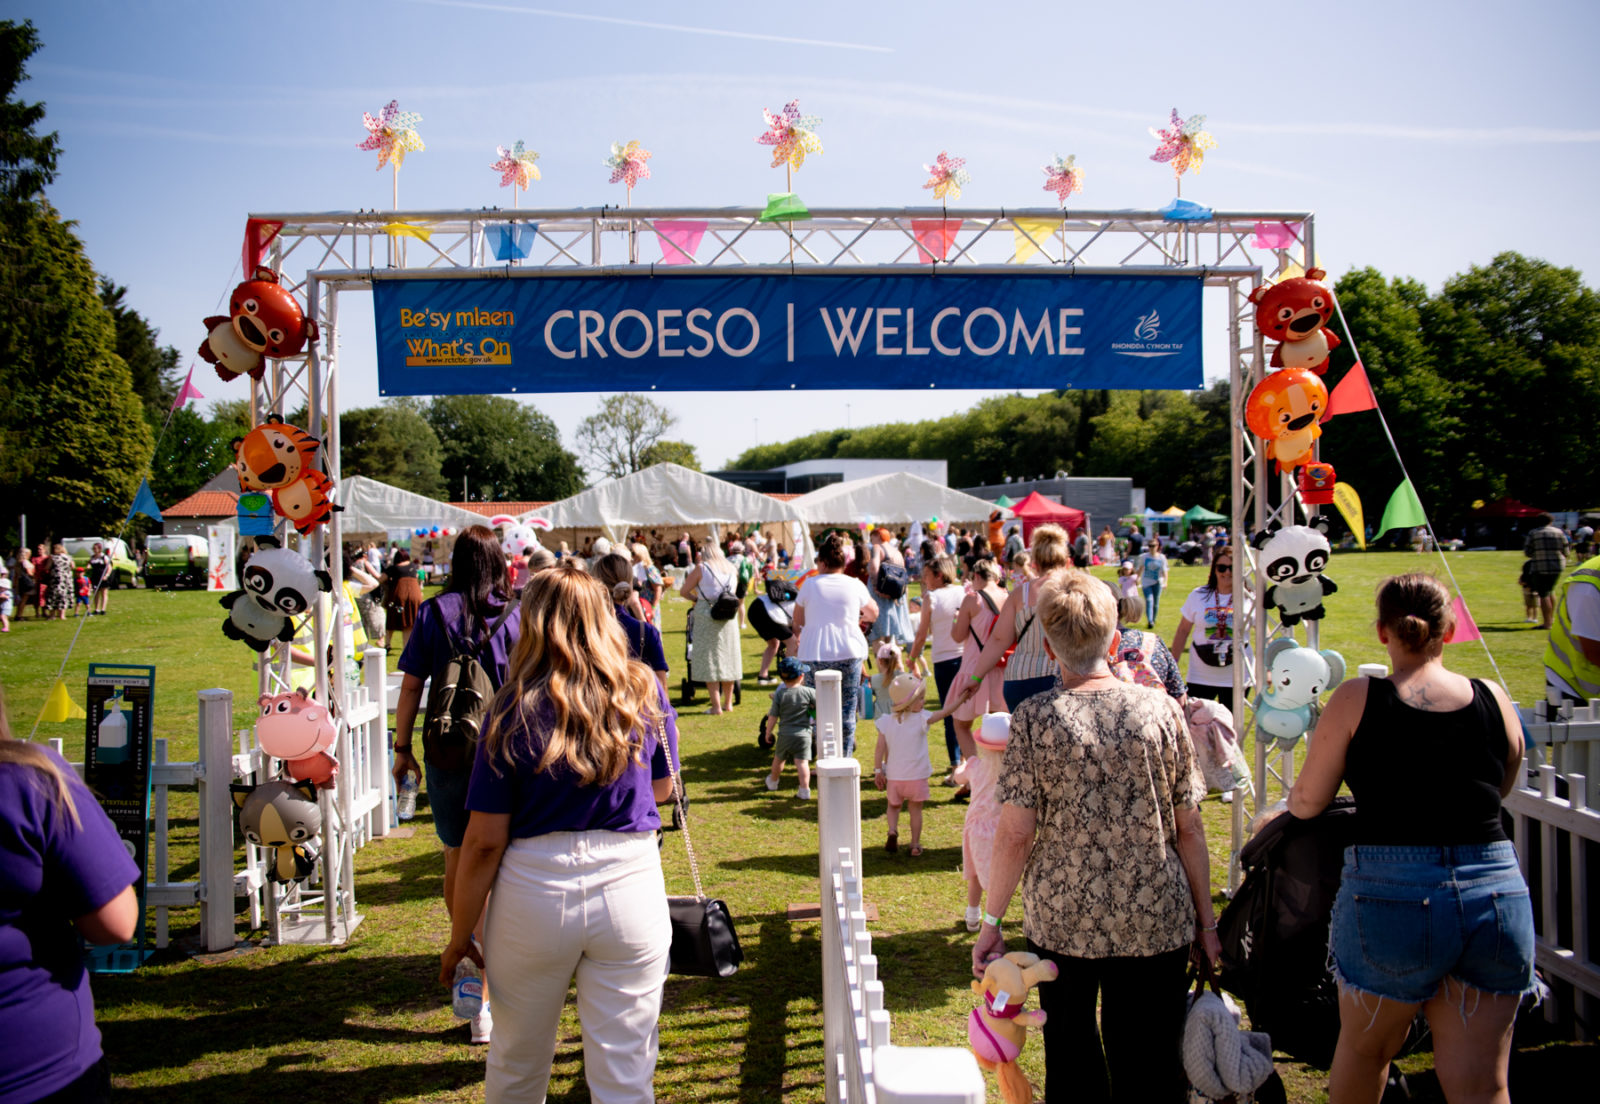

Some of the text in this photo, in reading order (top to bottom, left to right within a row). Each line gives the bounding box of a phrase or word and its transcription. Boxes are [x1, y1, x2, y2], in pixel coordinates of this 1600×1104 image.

[400, 306, 514, 331] Be'sy mlaen
[544, 306, 1086, 360] CROESO WELCOME
[406, 337, 511, 357] What's On
[1111, 342, 1145, 350] RHONDDA
